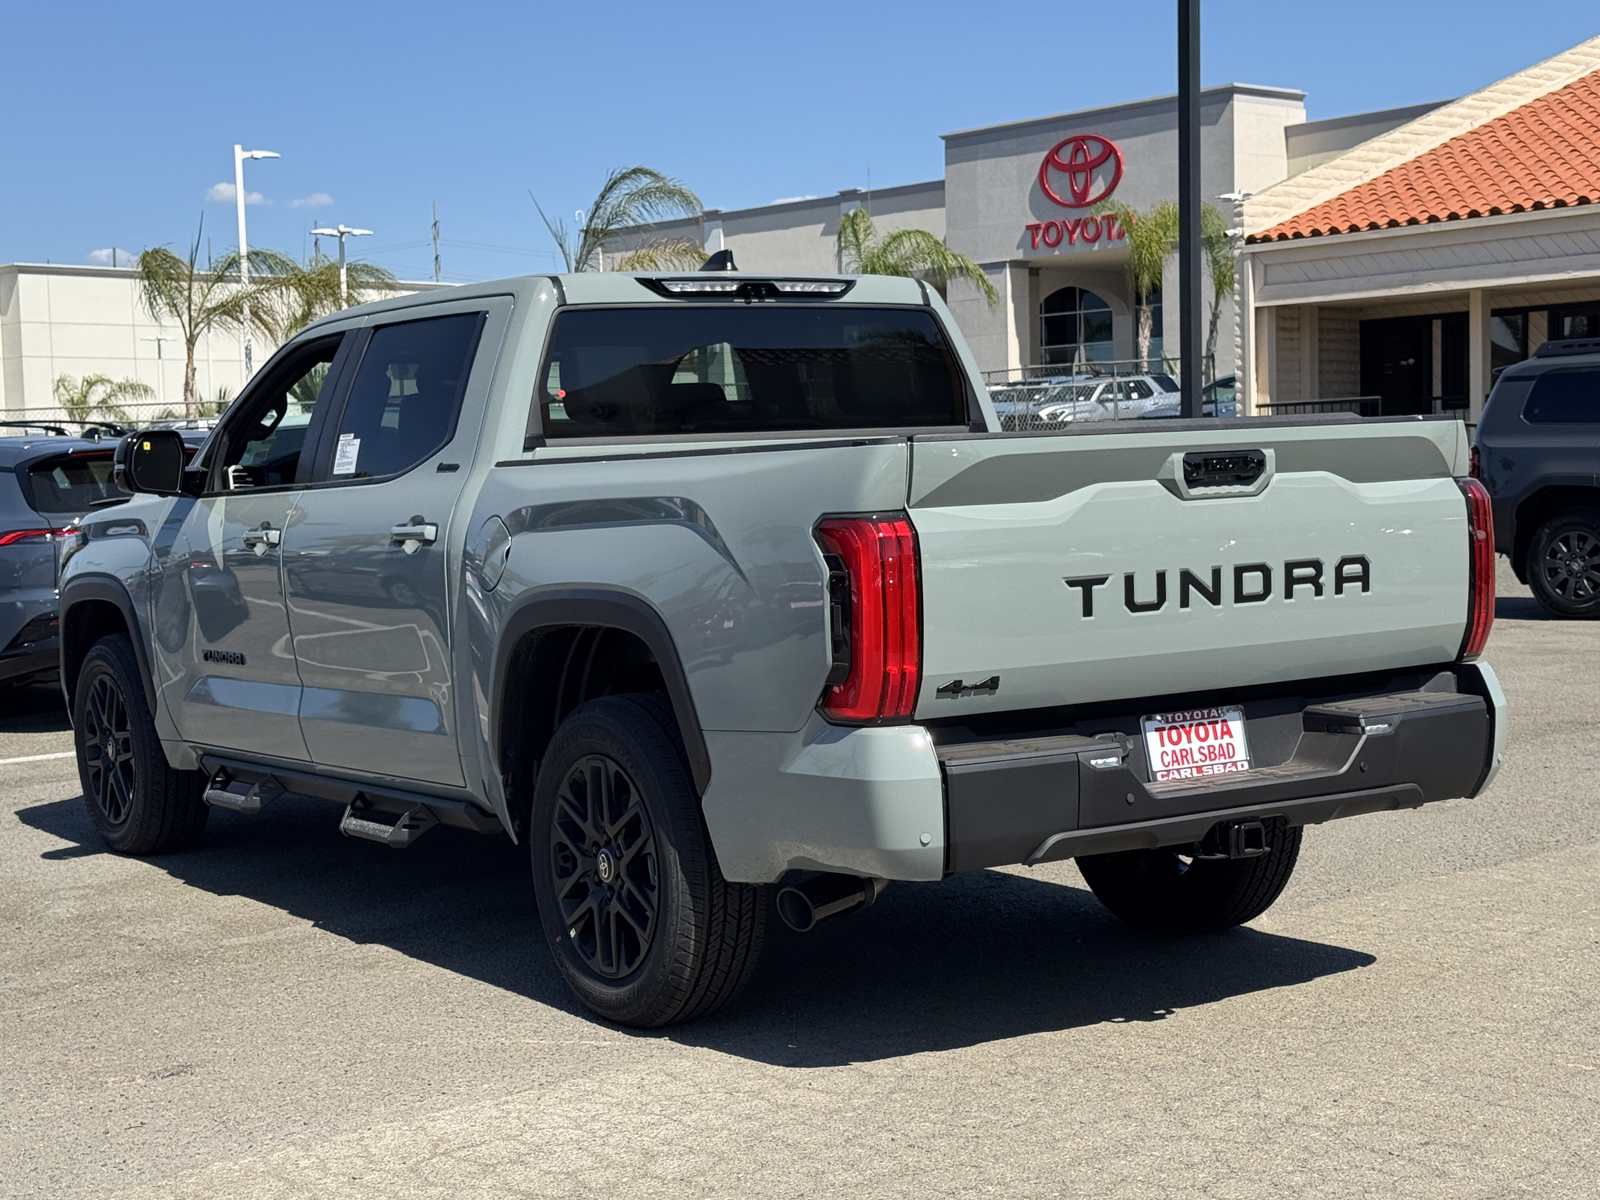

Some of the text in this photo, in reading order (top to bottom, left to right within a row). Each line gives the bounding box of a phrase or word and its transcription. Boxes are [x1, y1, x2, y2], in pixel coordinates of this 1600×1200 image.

[1062, 554, 1372, 619] TUNDRA
[1166, 708, 1219, 723] TOYOTA
[1154, 719, 1234, 748] TOYOTA
[1160, 742, 1236, 768] CARLSBAD
[1156, 761, 1250, 781] CARLSBAD
